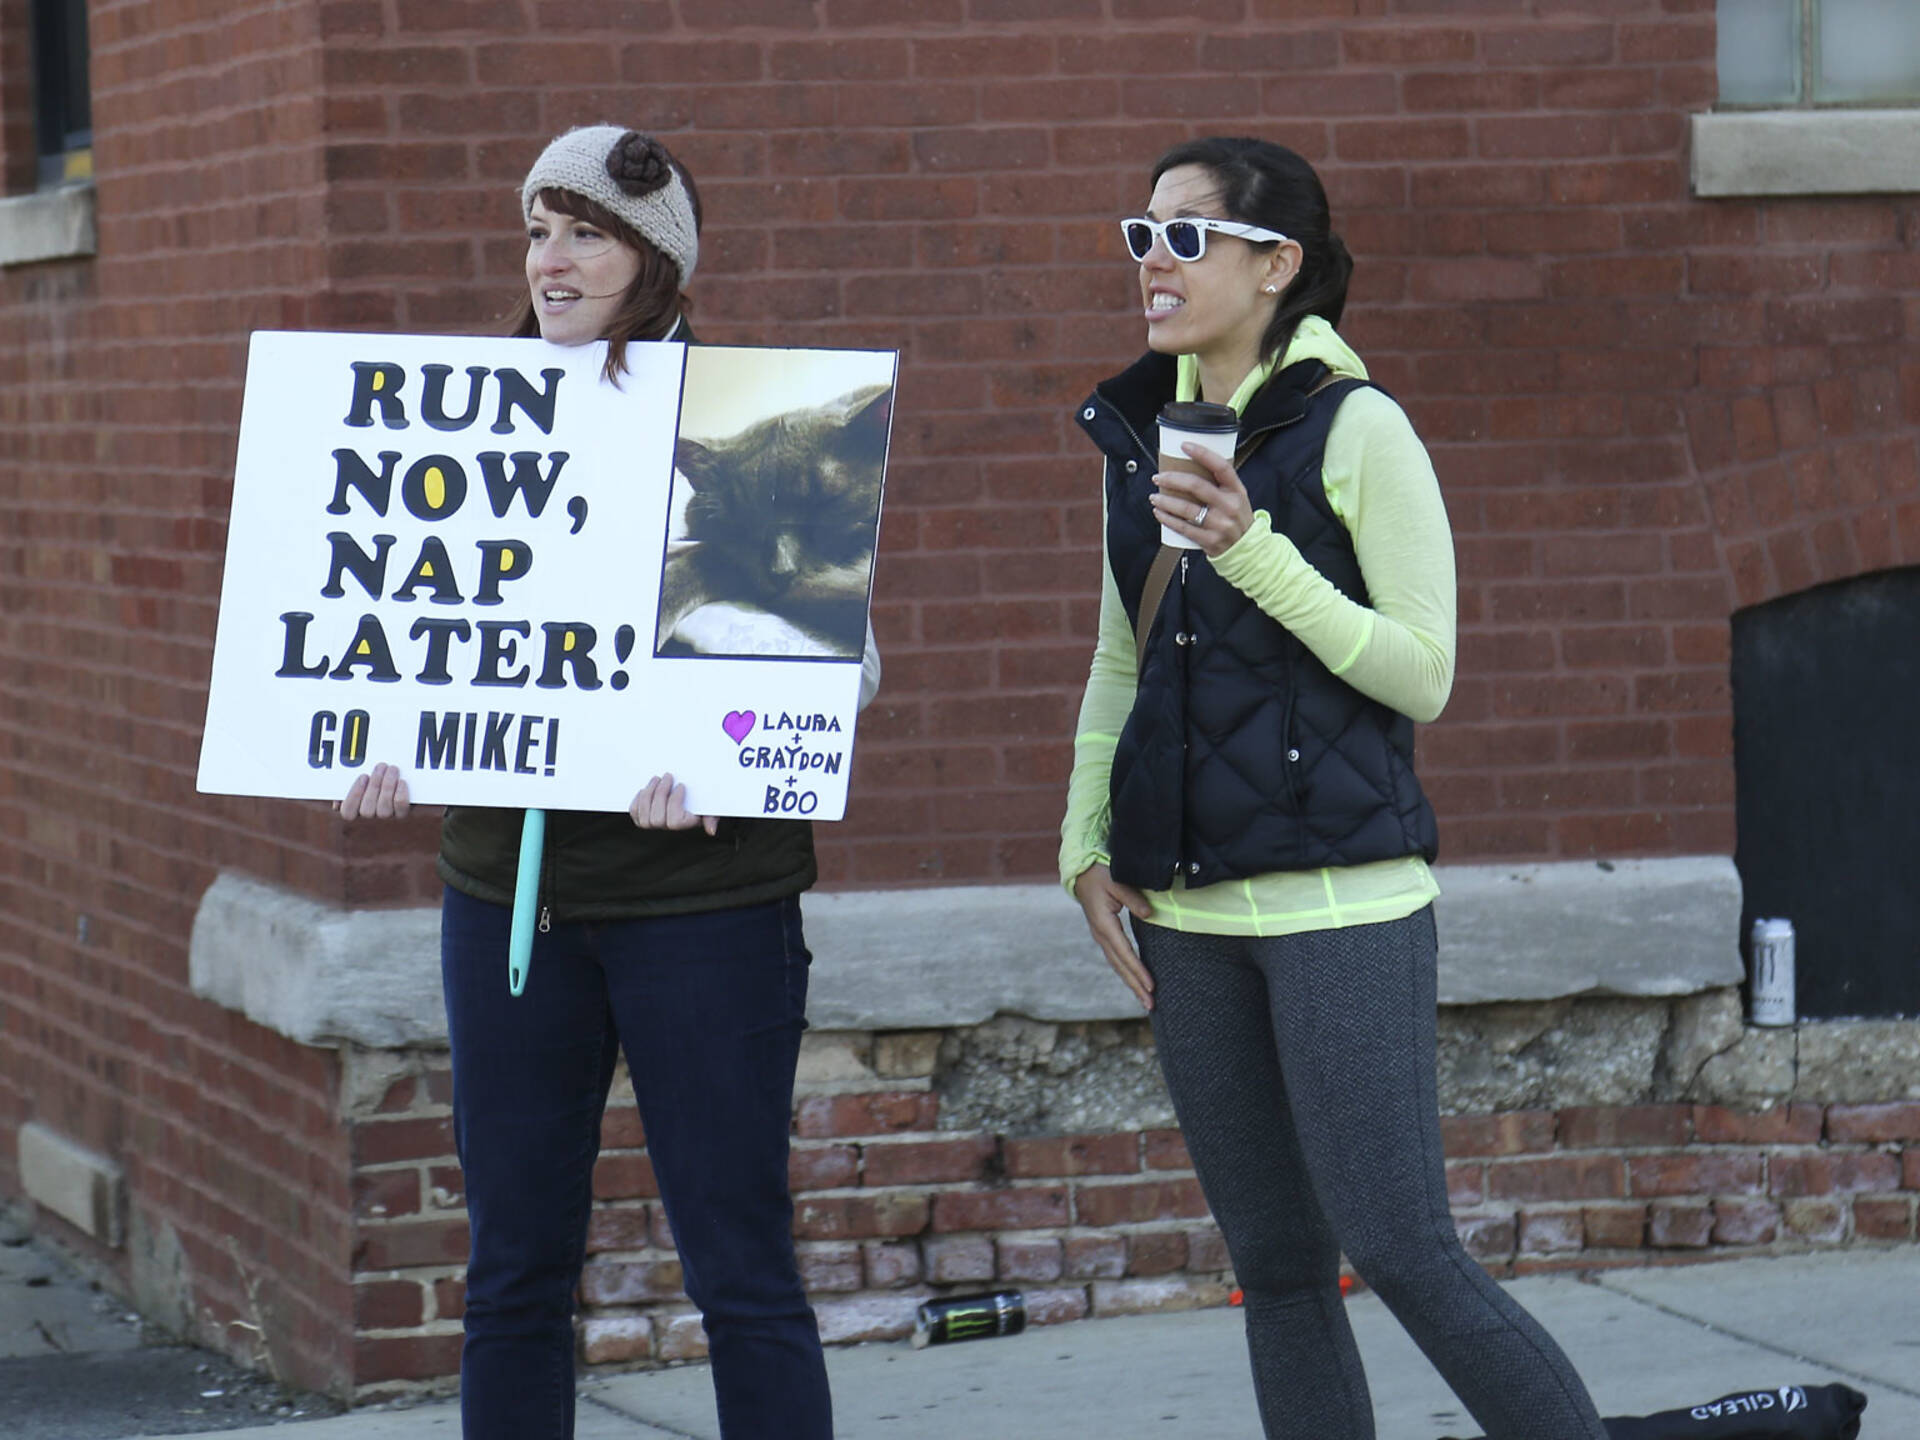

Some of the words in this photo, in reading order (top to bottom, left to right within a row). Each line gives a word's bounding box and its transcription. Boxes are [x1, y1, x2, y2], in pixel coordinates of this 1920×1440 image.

[344, 361, 565, 435] RUN
[326, 448, 588, 534] NOW,
[320, 532, 533, 606] NAP
[275, 612, 635, 690] LATER!
[308, 709, 370, 769] GO
[415, 711, 559, 776] MIKE!
[763, 712, 841, 732] LAURA
[739, 746, 842, 774] GRAYDON
[764, 785, 818, 814] BOO
[1690, 1392, 1775, 1420] GILEAD
